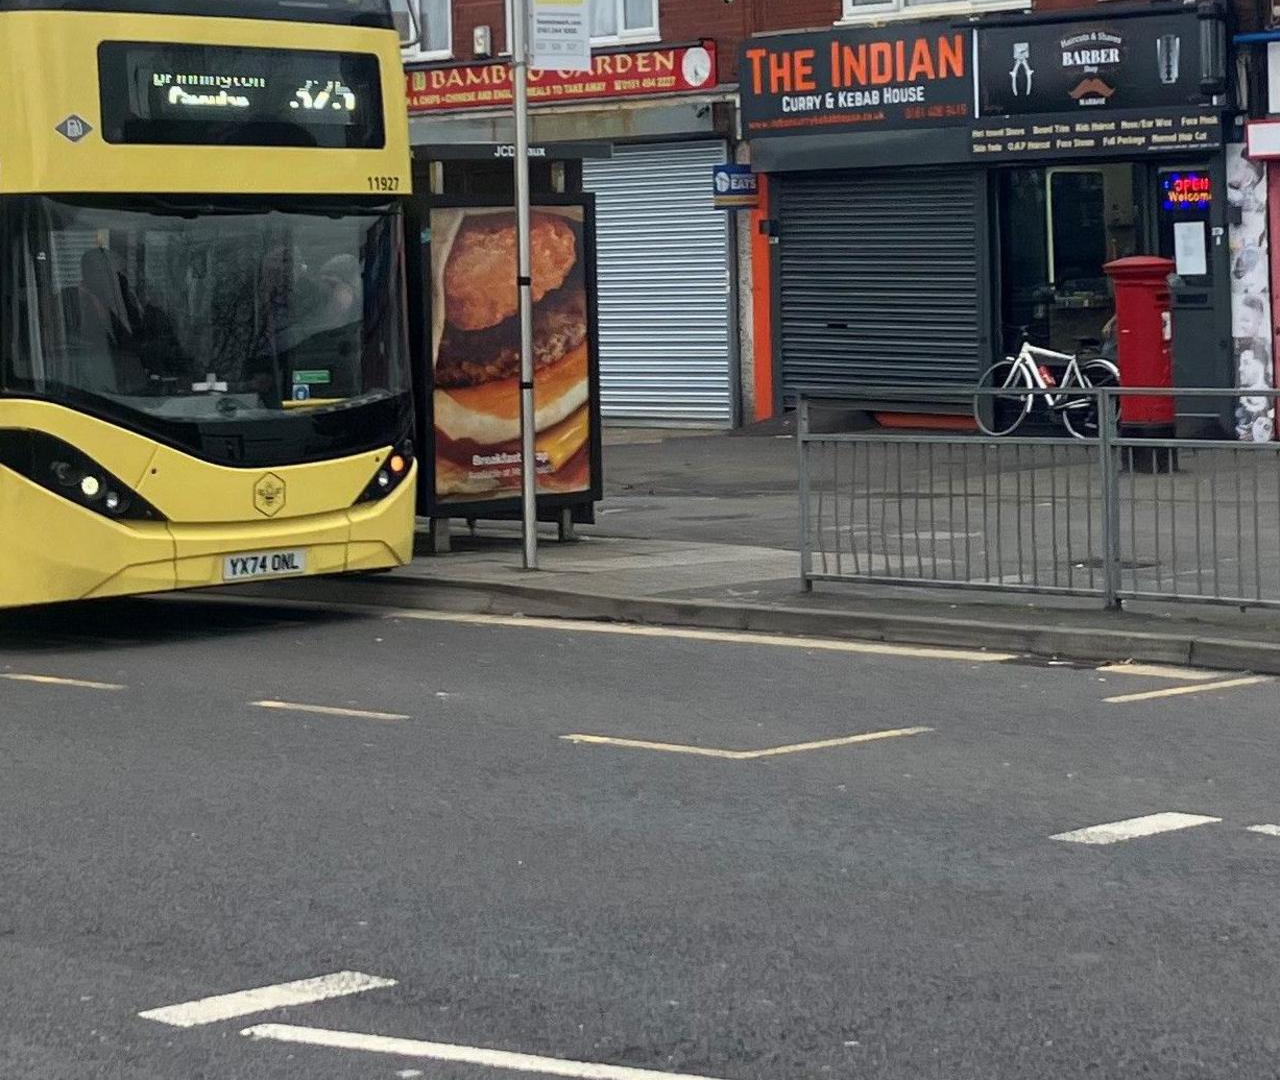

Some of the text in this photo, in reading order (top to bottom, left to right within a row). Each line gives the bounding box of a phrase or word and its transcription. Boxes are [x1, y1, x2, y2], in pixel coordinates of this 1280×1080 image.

[745, 34, 965, 95] THE INDIAN
[1062, 48, 1120, 67] BARBER
[782, 86, 925, 112] CURRY & KEBAB HOUSE
[494, 145, 546, 158] JCDaux
[367, 176, 400, 191] 11927
[229, 552, 300, 576] YX74 ONL
